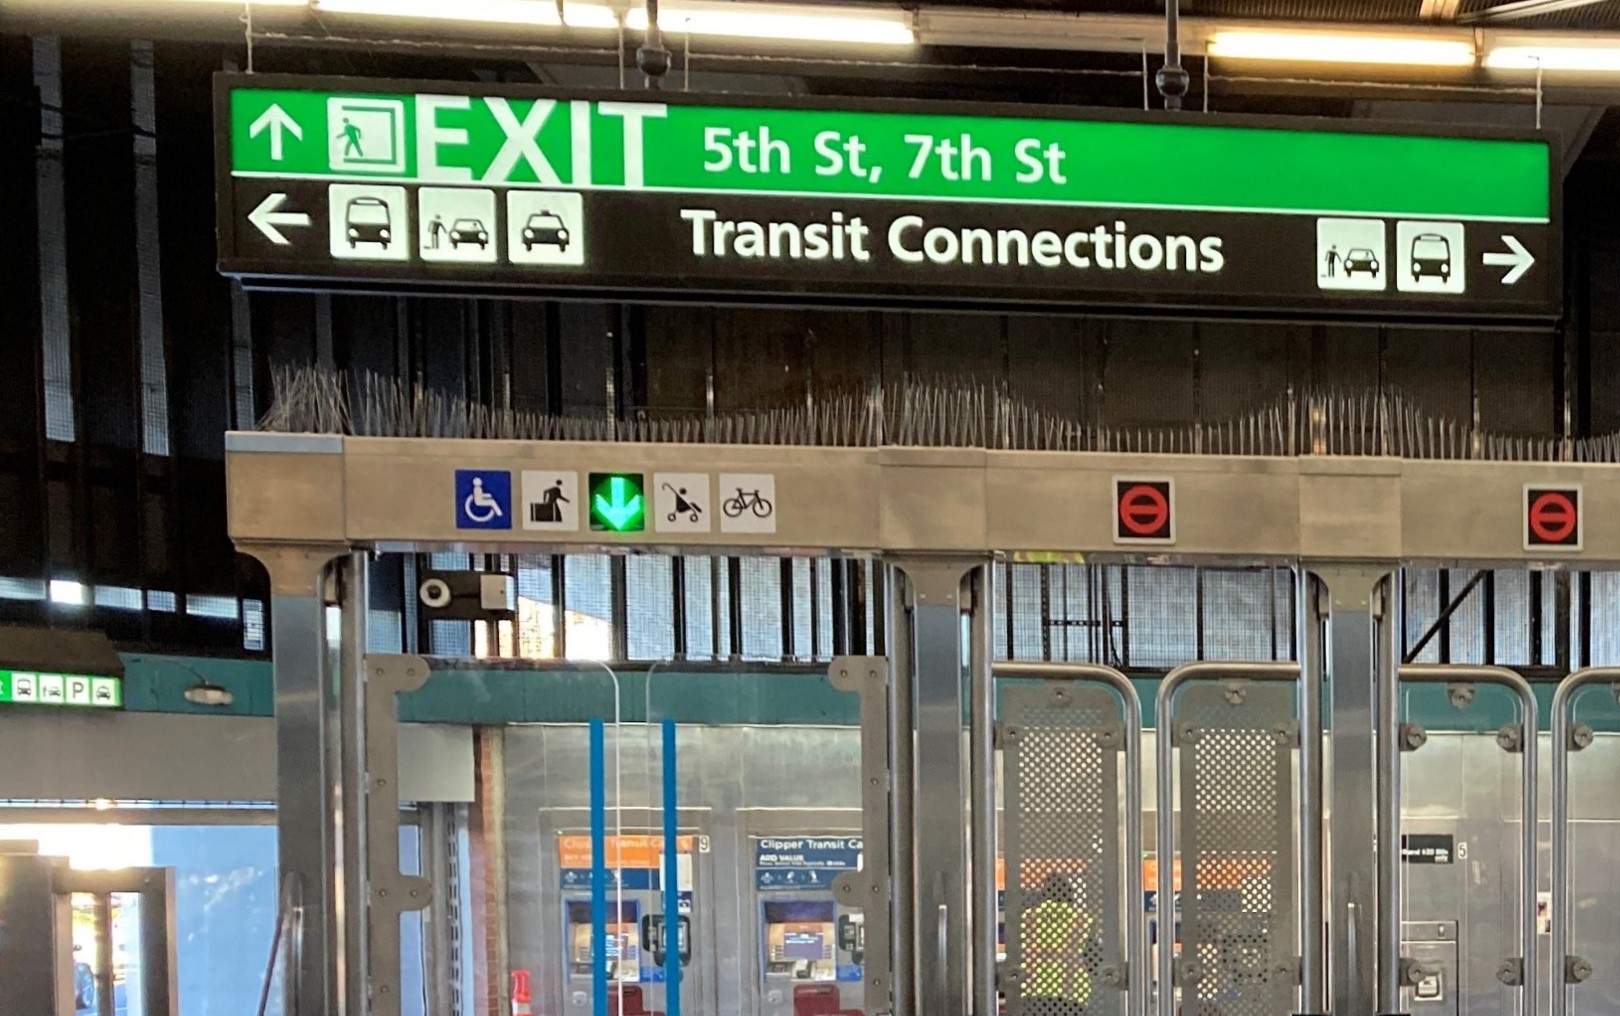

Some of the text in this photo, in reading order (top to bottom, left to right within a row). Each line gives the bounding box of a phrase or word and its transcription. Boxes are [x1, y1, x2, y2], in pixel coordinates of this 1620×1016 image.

[415, 94, 668, 188] EXIT
[703, 126, 1067, 185] 5th St, 7th St
[681, 209, 1225, 273] Transit Connections
[700, 836, 707, 851] 9
[760, 839, 804, 850] Clipper
[806, 839, 844, 849] Transit
[1459, 844, 1466, 858] 5
